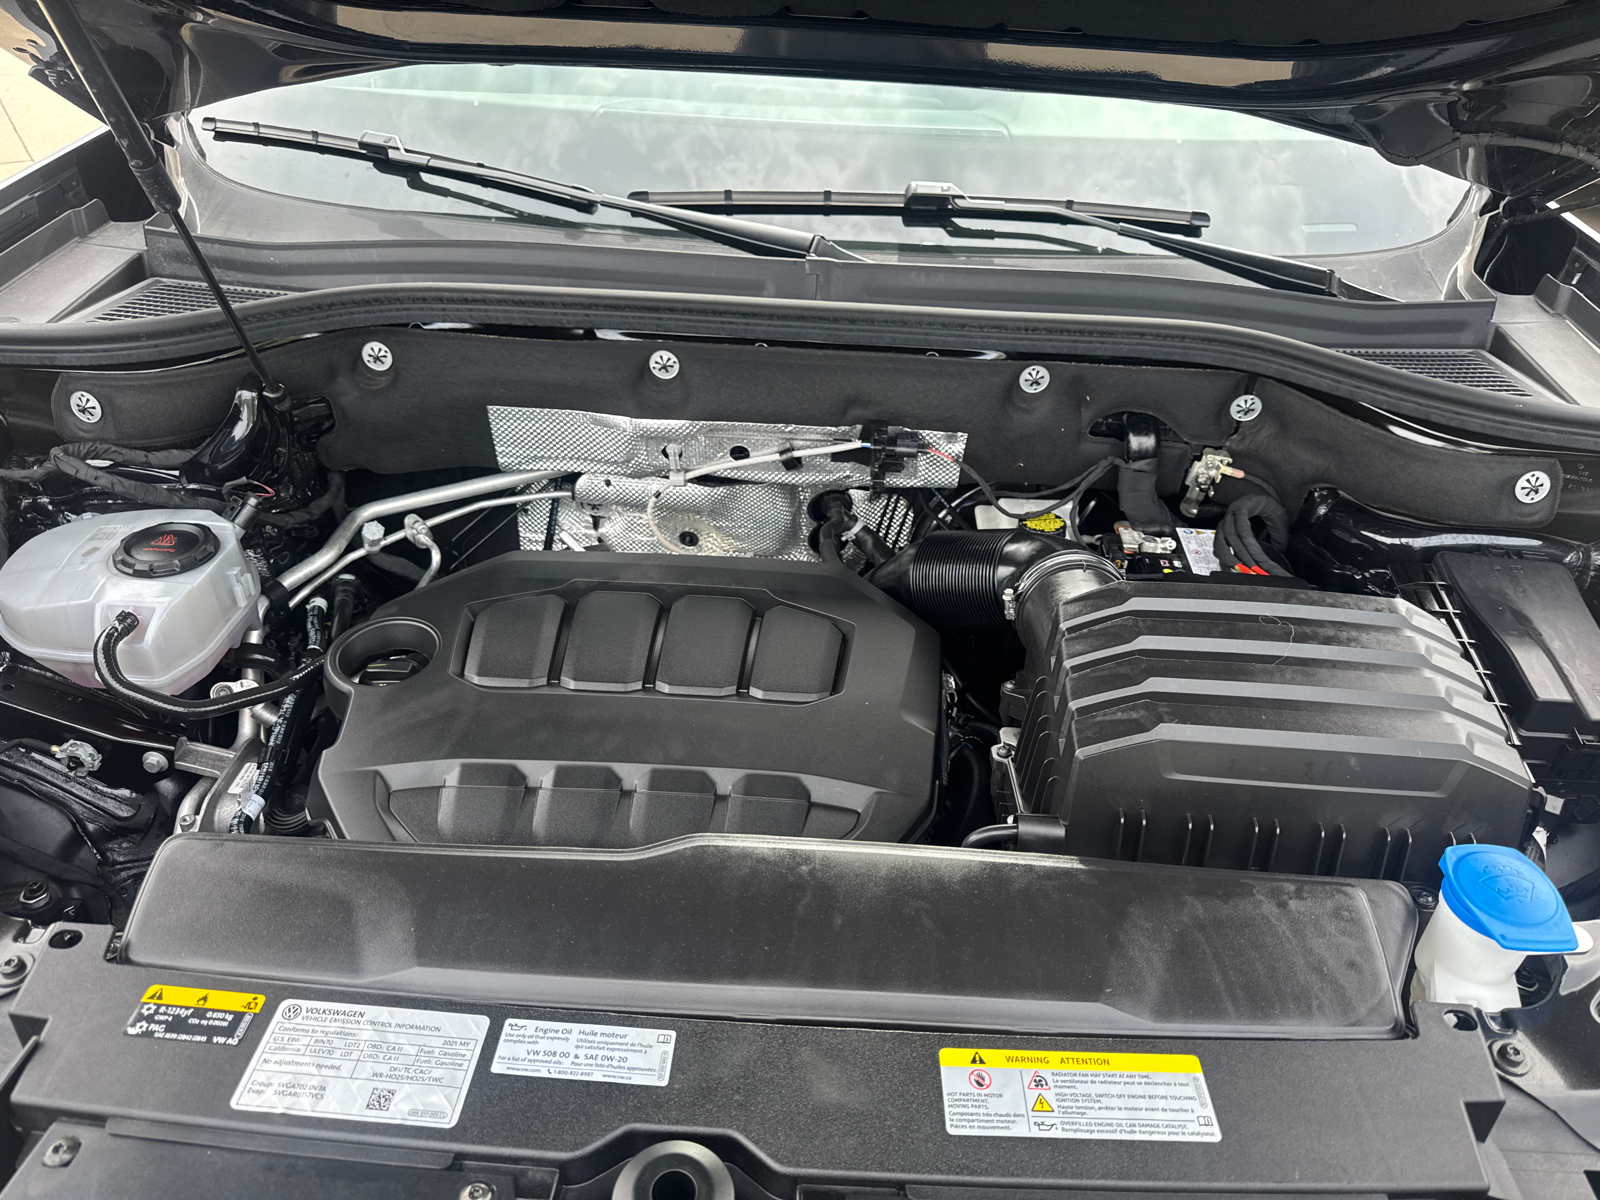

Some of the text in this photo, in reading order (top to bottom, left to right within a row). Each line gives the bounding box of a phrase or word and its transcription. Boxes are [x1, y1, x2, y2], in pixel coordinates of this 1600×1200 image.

[159, 1006, 194, 1018] R-1234yf
[305, 1007, 366, 1018] VOLKSWAGEN
[148, 1023, 166, 1032] PAG
[329, 1017, 361, 1025] EMISSION
[362, 1019, 392, 1028] CONTROL
[394, 1023, 441, 1032] INFORMATION
[278, 1025, 310, 1034] Conforms
[320, 1029, 358, 1037] regulations:
[534, 1026, 560, 1035] Engine
[438, 1050, 467, 1058] Gasoline
[600, 1054, 628, 1063] 0W-20
[273, 1059, 314, 1068] adjustments
[435, 1060, 464, 1068] Gasoline
[1005, 1055, 1110, 1066] WARNING ATTENTION
[251, 1080, 275, 1088] Group:
